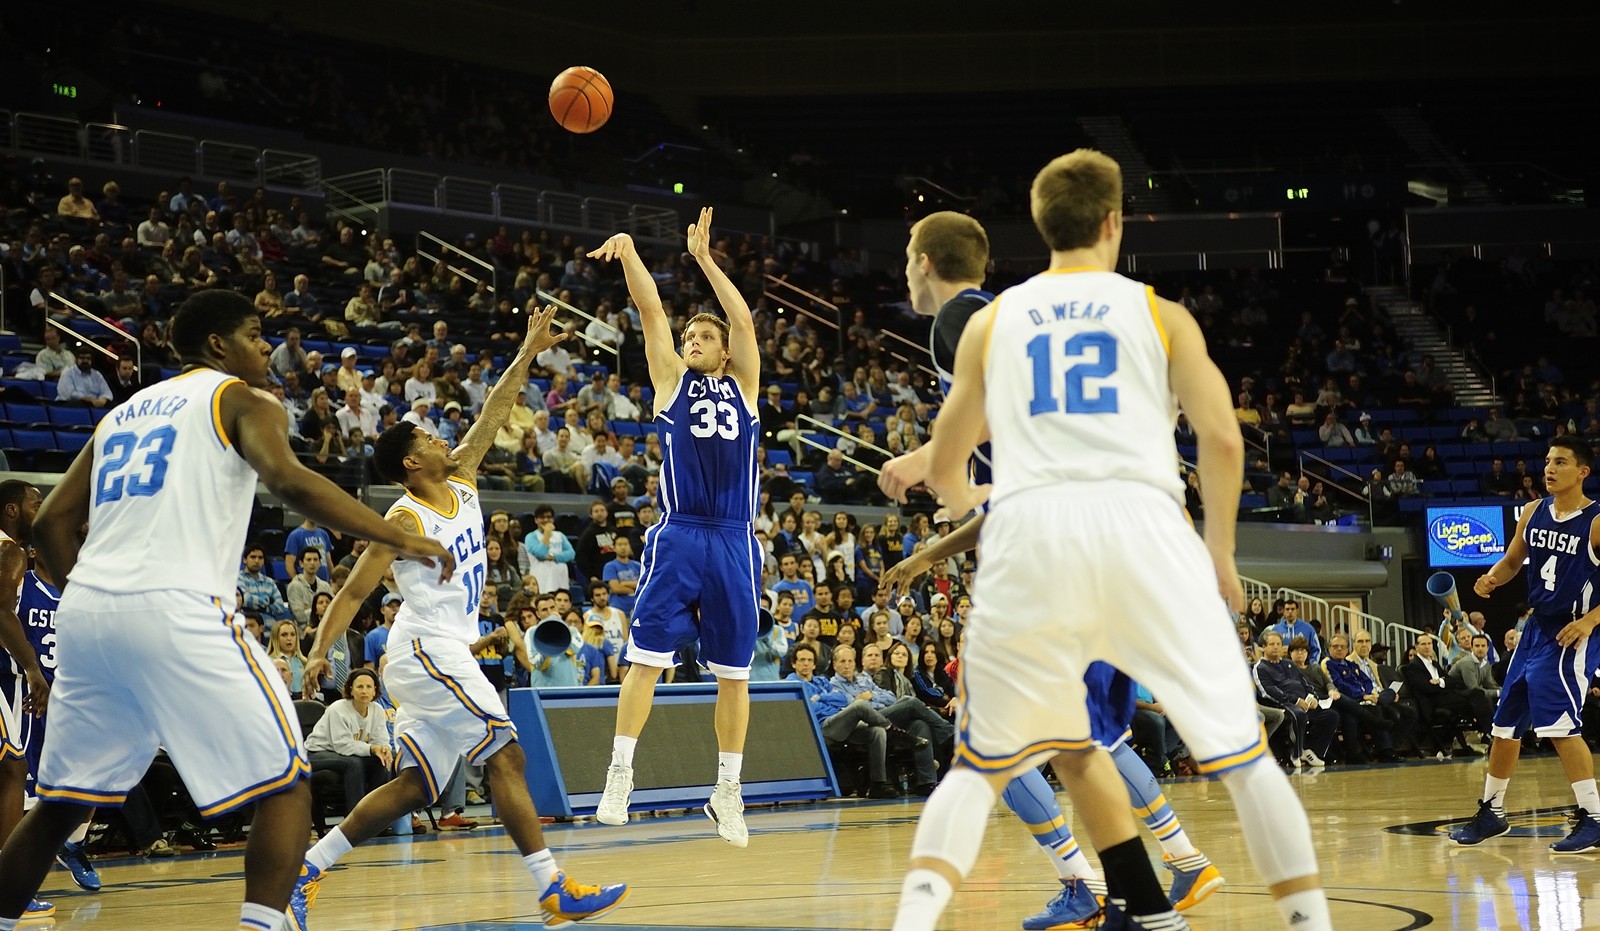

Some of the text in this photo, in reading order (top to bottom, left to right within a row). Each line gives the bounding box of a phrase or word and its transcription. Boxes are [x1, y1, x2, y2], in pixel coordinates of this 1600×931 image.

[688, 376, 736, 400] CSUM
[1026, 330, 1119, 417] 12
[115, 395, 188, 427] PARKER
[690, 398, 740, 441] 33
[95, 424, 177, 508] 23
[1437, 521, 1470, 539] Living
[1447, 533, 1493, 551] Spaces
[1529, 528, 1581, 555] CSUSM
[462, 562, 484, 615] 10
[1540, 554, 1558, 591] 4
